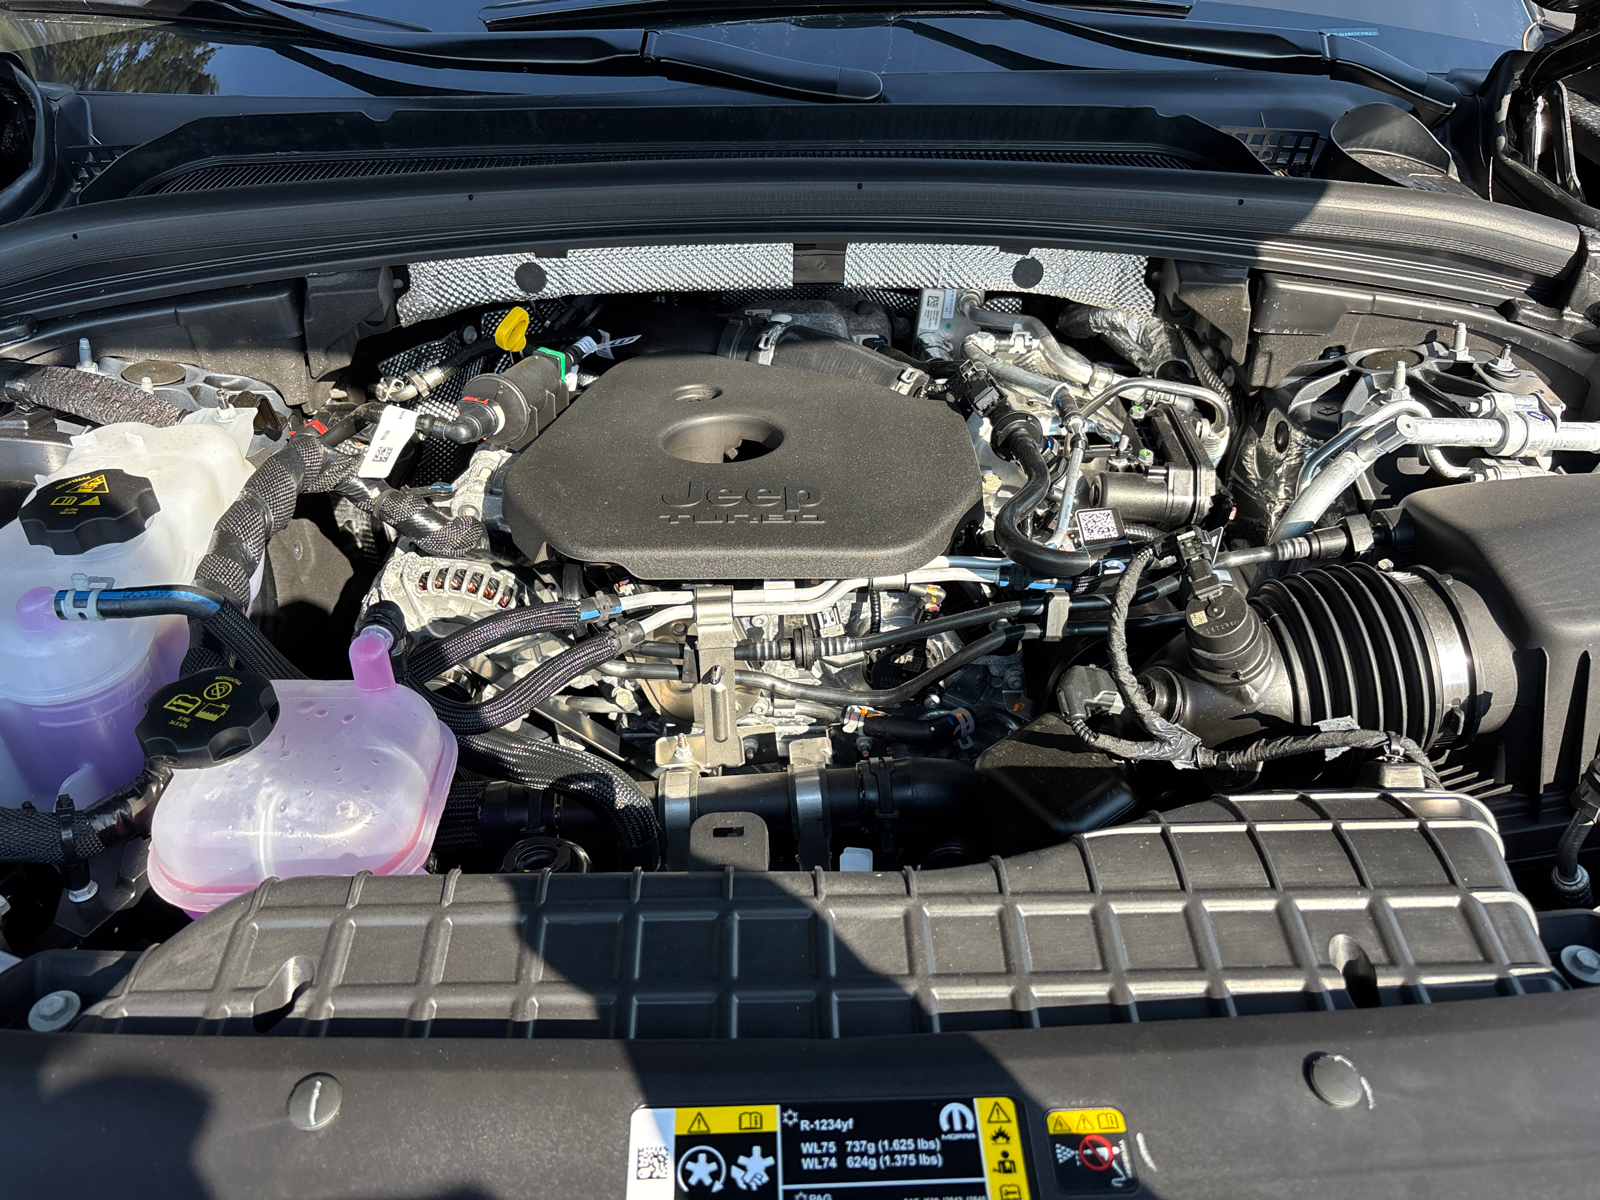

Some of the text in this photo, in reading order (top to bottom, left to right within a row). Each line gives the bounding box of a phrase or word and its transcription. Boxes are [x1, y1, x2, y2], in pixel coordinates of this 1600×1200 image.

[661, 480, 823, 513] Jeep
[658, 514, 826, 525] TURBO
[800, 1118, 854, 1133] R-1234yf
[941, 1132, 977, 1141] MOPAR
[800, 1138, 942, 1155] WL75 737g (1.625 lbs)
[801, 1153, 943, 1171] WL74 624g (1.375 lbs)
